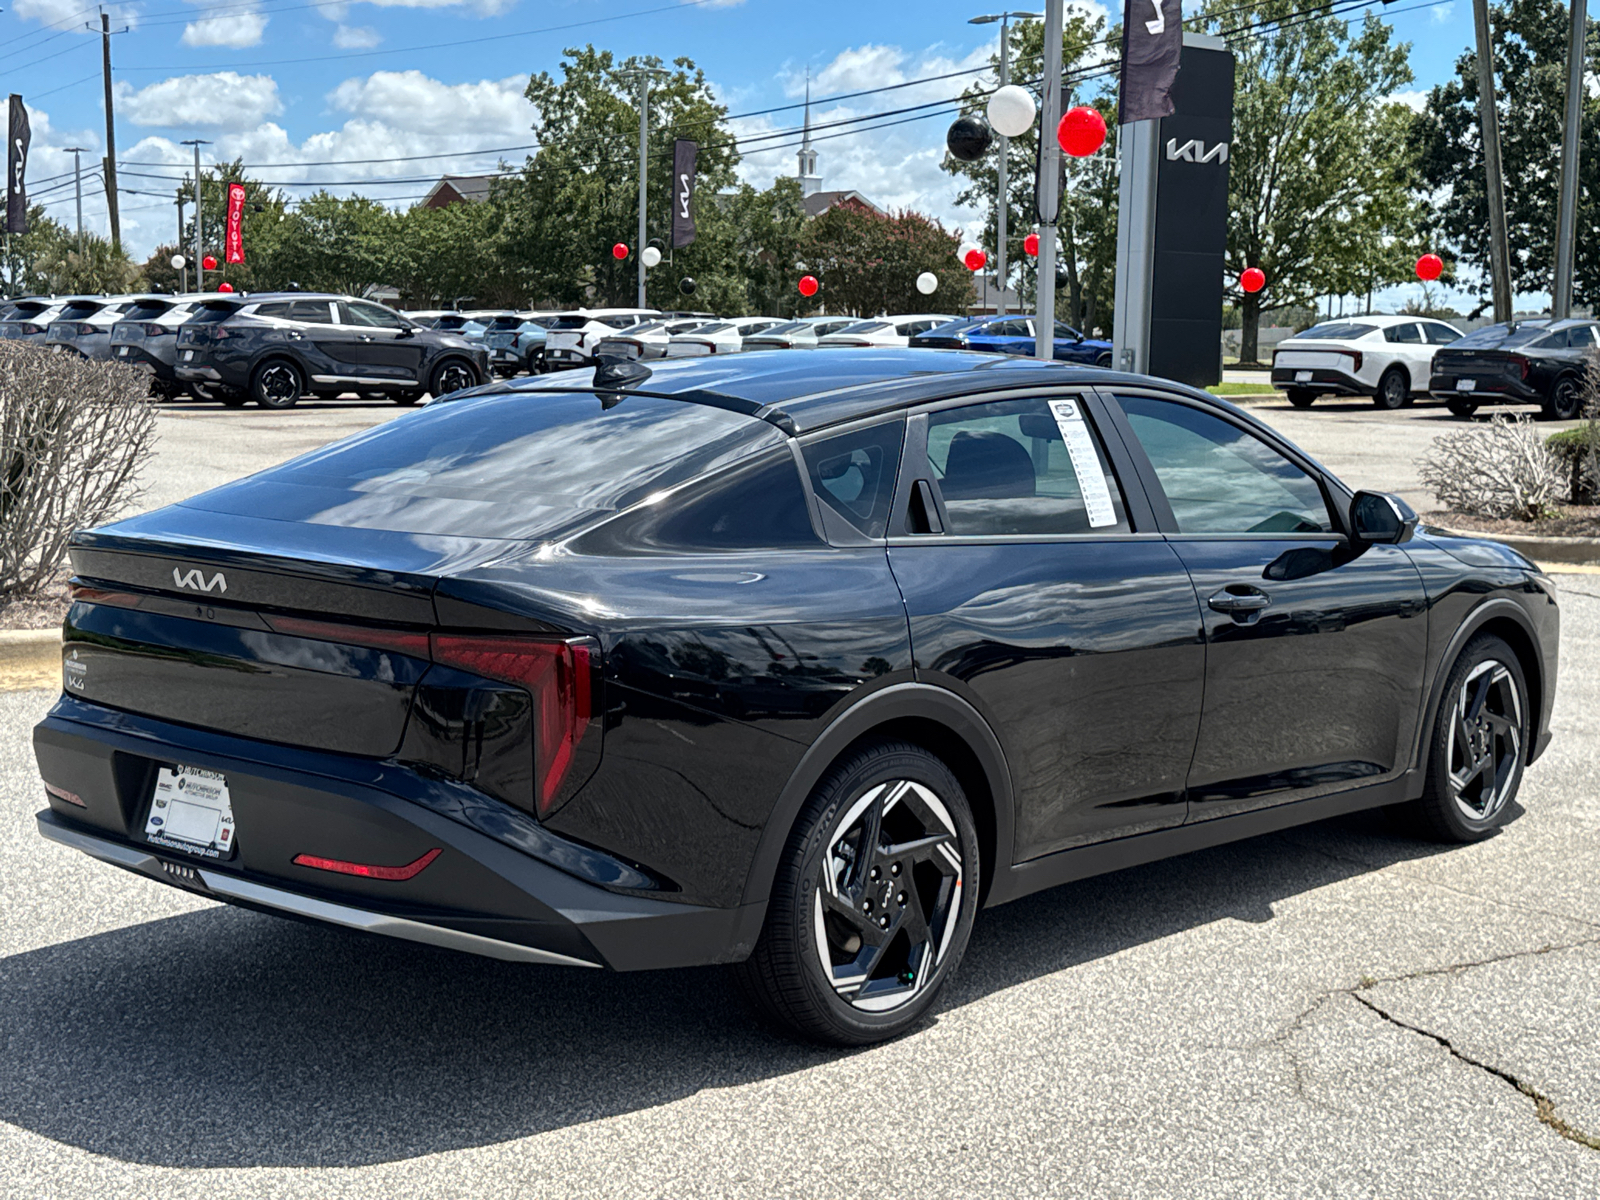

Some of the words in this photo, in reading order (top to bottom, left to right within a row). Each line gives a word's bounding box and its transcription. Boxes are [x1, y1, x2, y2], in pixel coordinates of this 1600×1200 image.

[1167, 137, 1228, 165] KIA
[231, 201, 241, 261] TOYOTA
[172, 566, 228, 594] KIA
[798, 877, 811, 954] KUMHO
